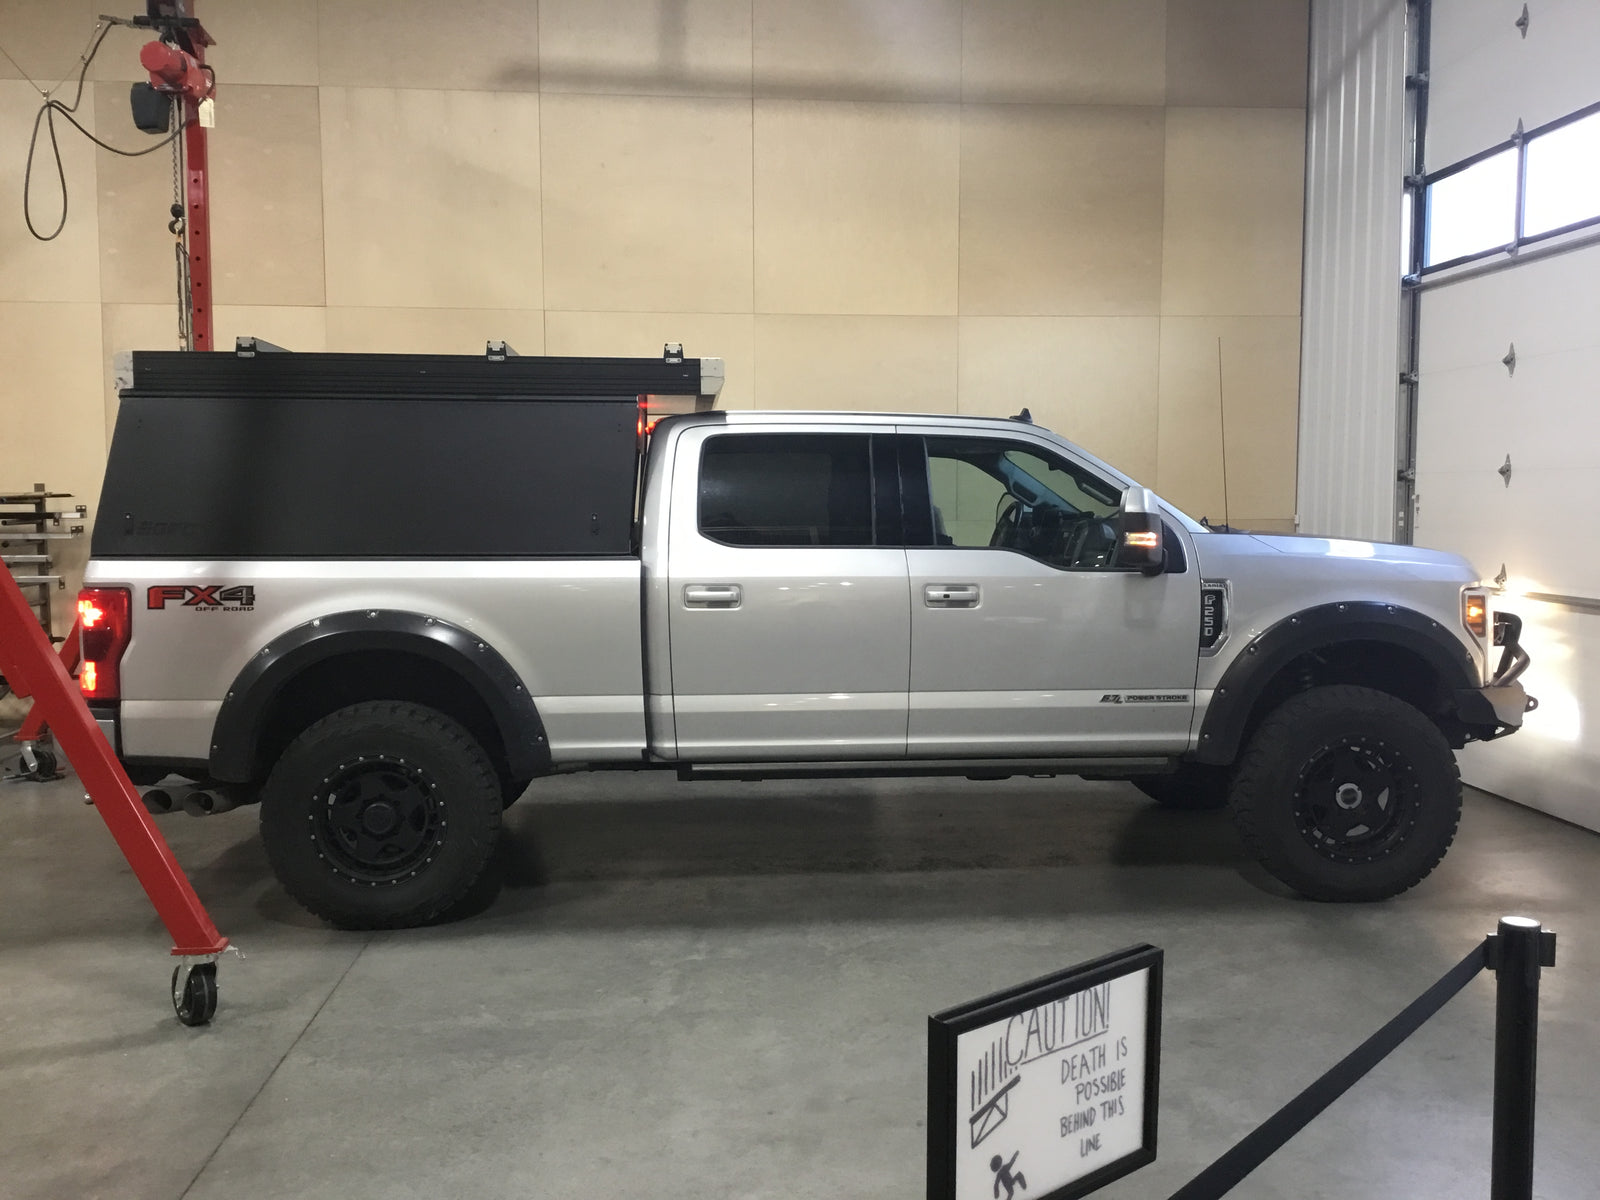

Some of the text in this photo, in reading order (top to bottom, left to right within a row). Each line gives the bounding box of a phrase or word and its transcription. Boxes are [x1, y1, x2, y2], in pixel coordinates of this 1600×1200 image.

[147, 585, 255, 610] FX4
[1005, 981, 1111, 1067] CAUTION!
[1061, 1036, 1128, 1085] DEATH IS
[1075, 1067, 1126, 1105] POSSIBLE
[1060, 1094, 1125, 1138] BEHIND THIS
[1080, 1133, 1102, 1158] LINE
